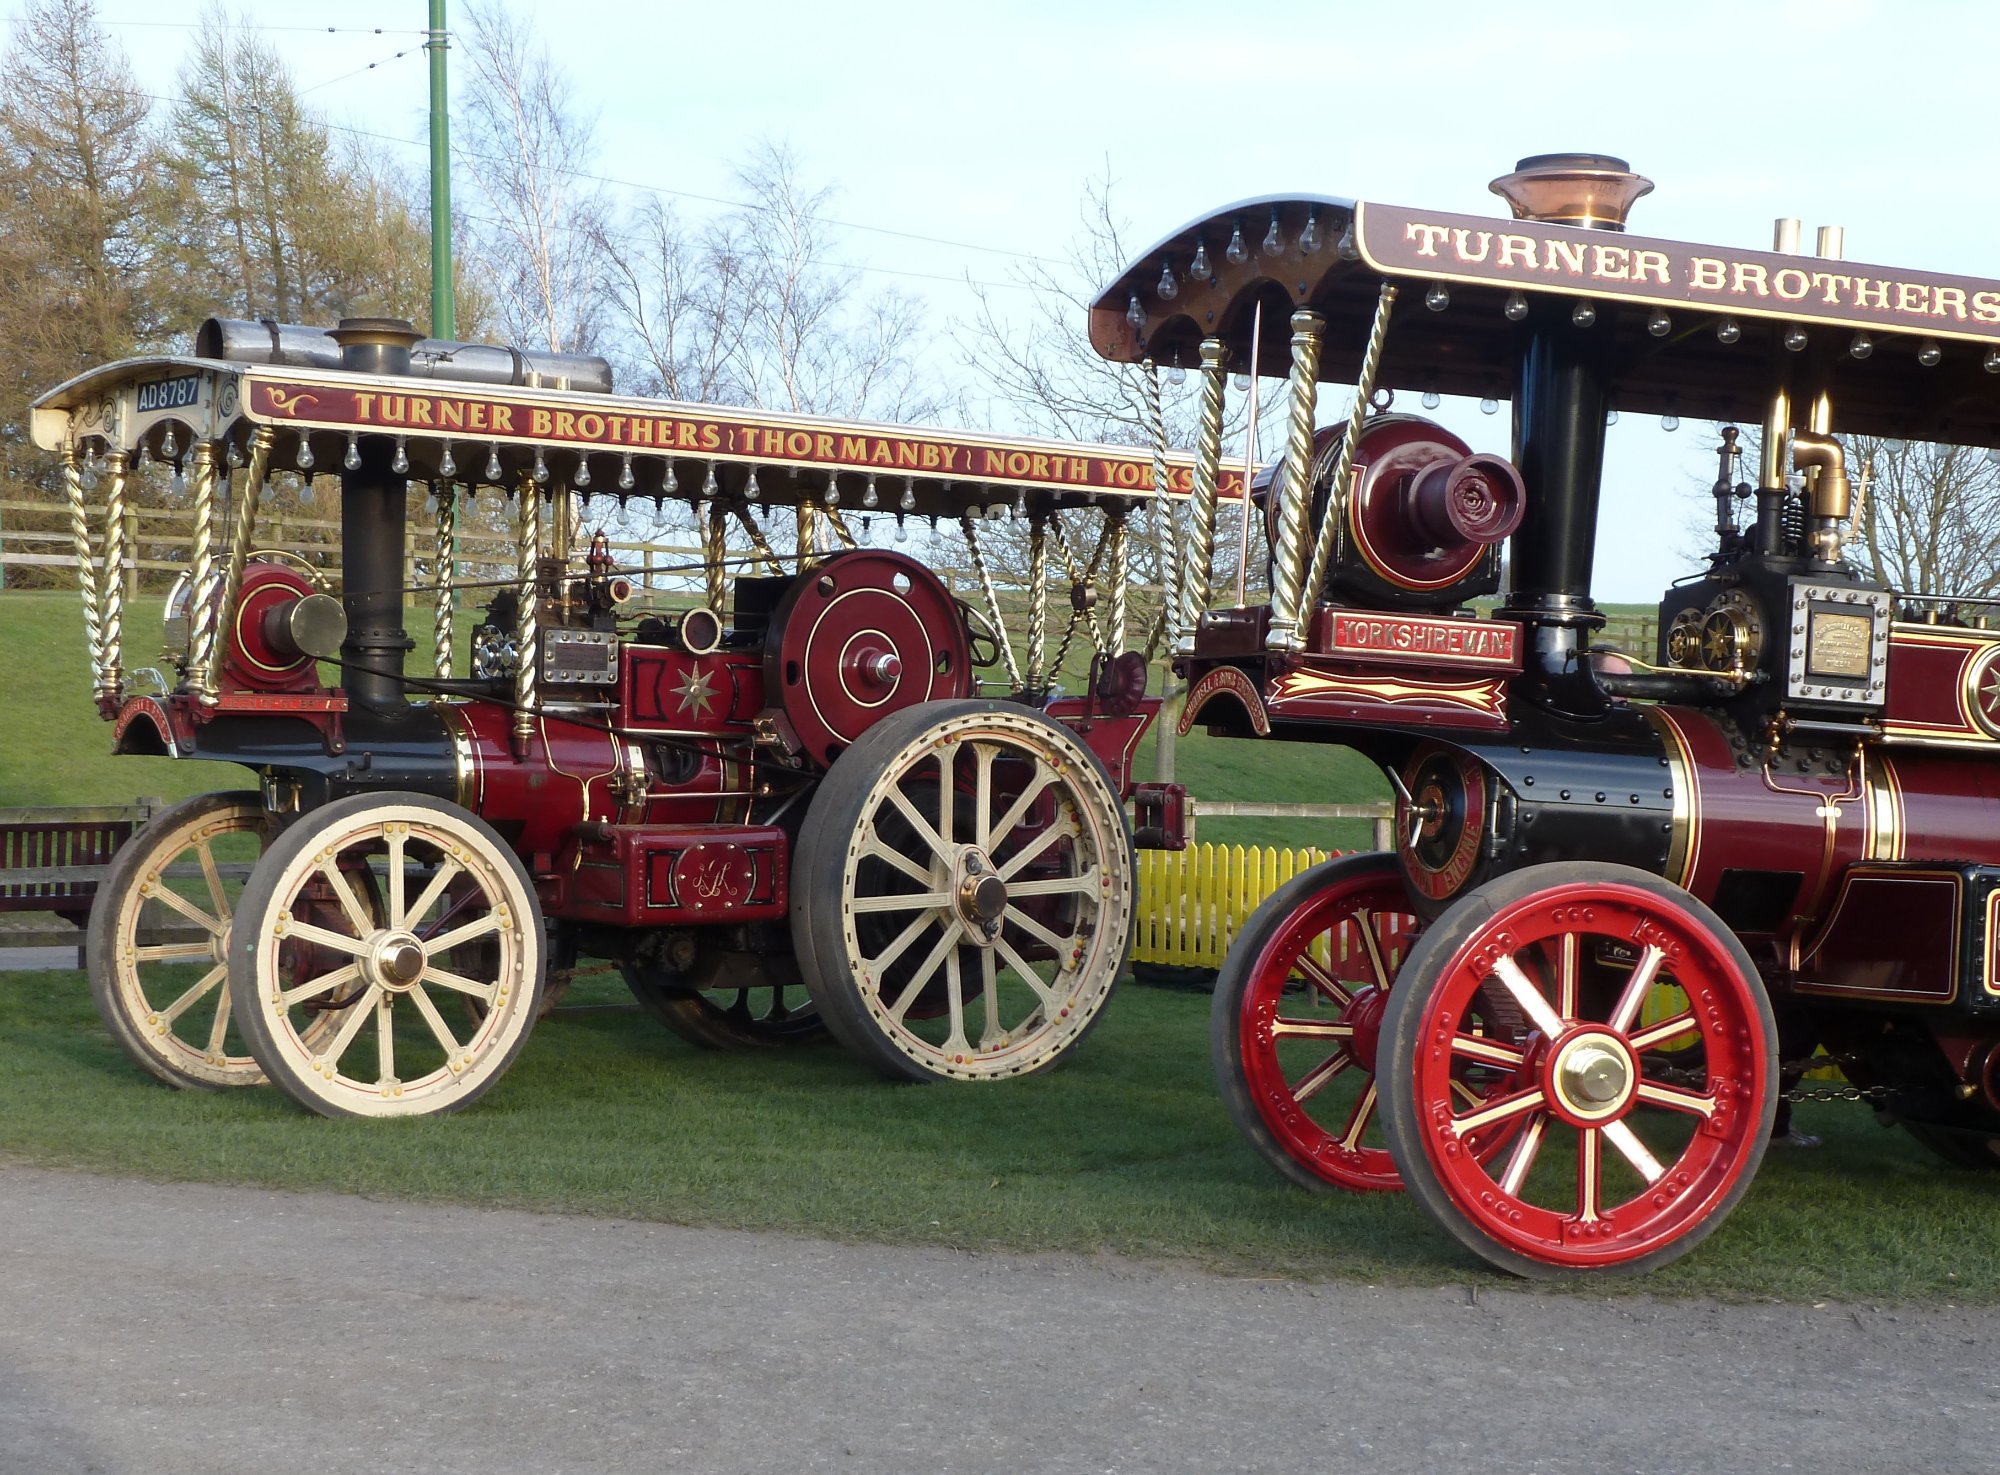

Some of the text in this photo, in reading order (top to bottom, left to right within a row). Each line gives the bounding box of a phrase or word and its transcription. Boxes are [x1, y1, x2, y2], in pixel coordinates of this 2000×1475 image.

[1405, 222, 2000, 322] TURNER BROTHERS
[139, 377, 198, 410] AD8787
[354, 392, 514, 432] TURNER
[531, 409, 721, 448] BROTHERS
[741, 427, 958, 468] THORMANBY
[984, 450, 1089, 482] NORTH
[1343, 620, 1506, 655] YORKSHIREMAN
[1443, 821, 1480, 891] ENGINE
